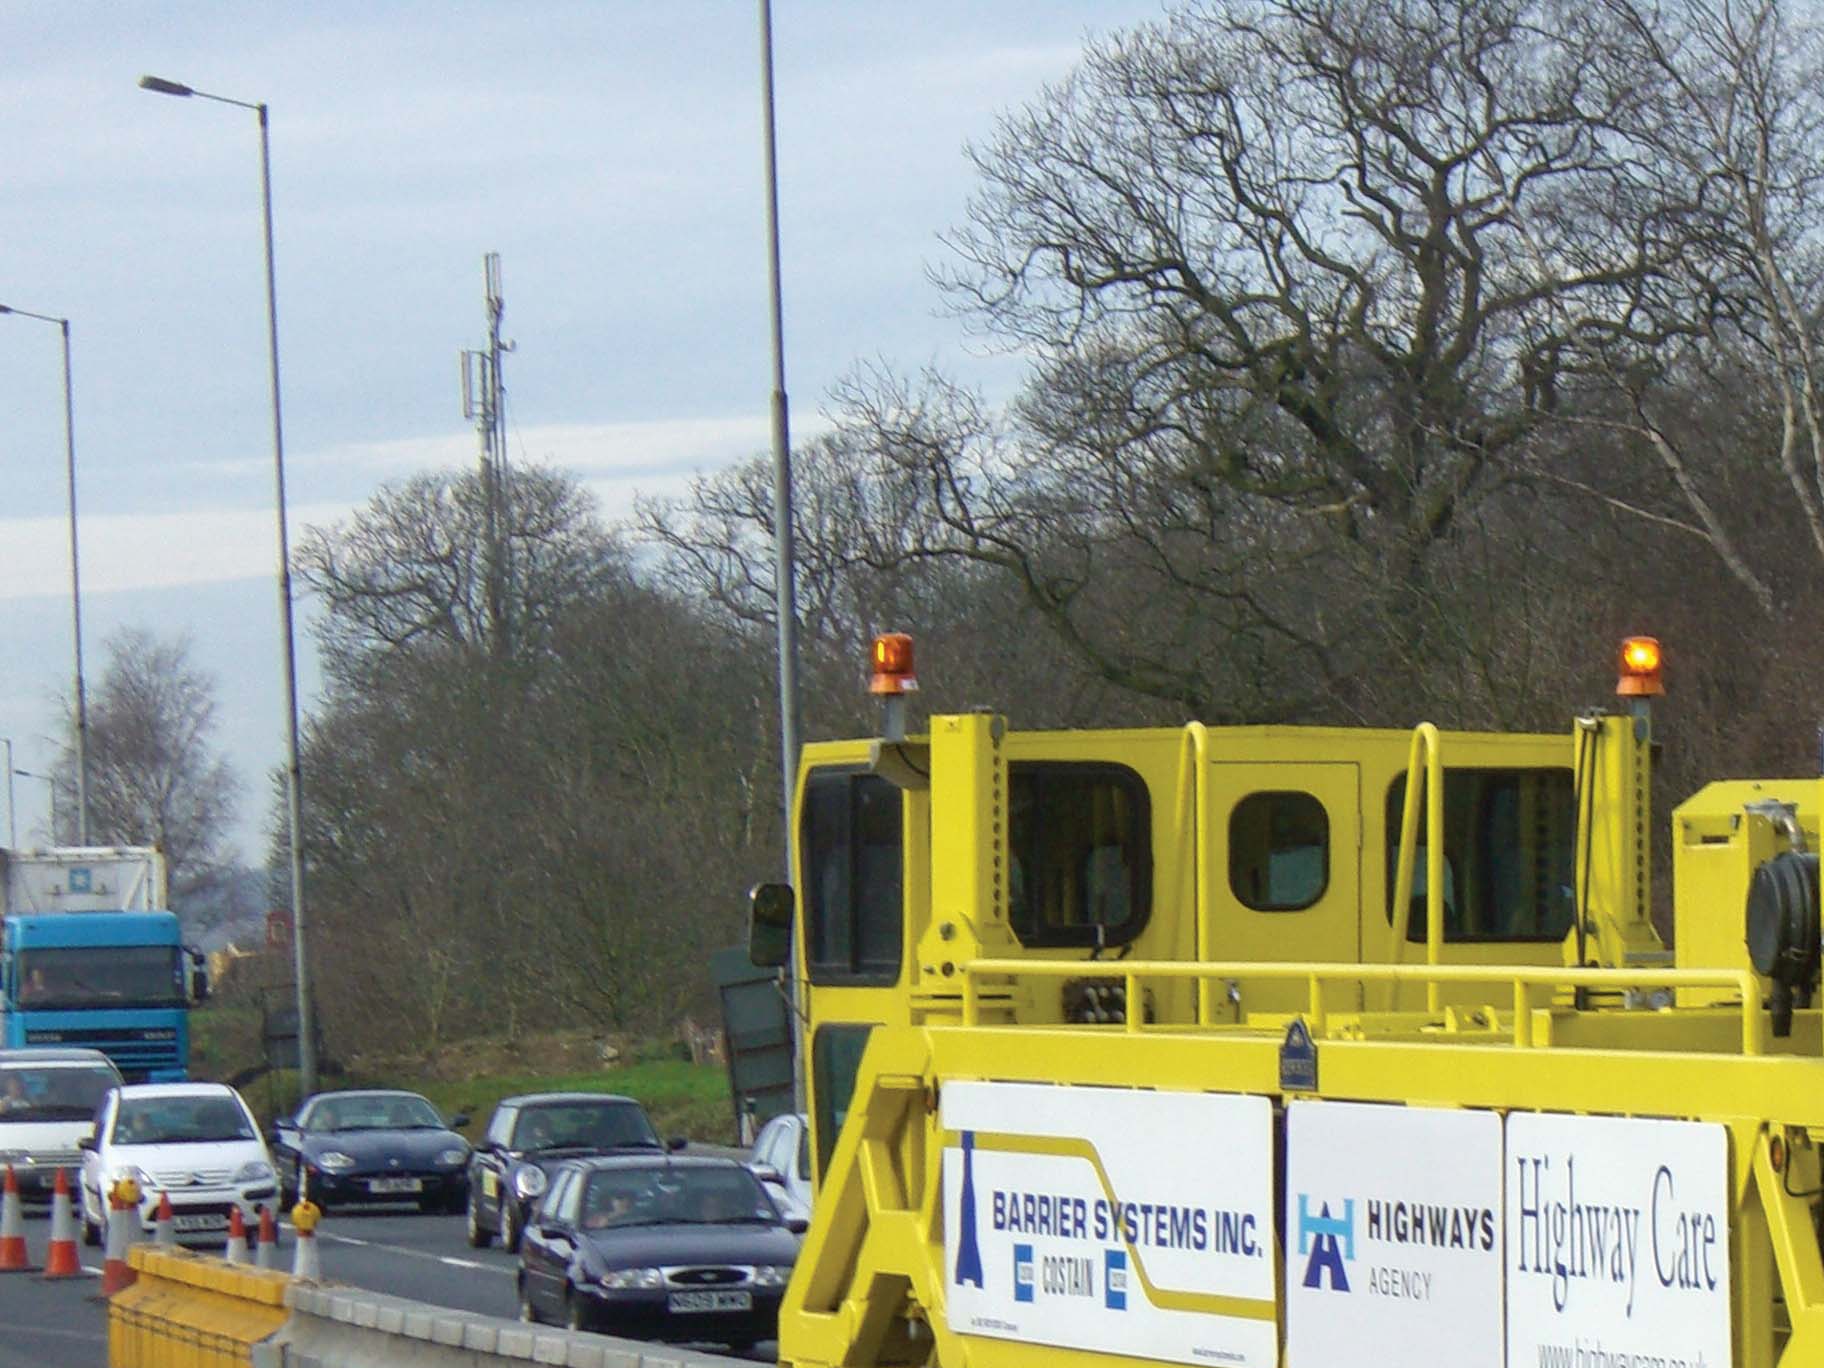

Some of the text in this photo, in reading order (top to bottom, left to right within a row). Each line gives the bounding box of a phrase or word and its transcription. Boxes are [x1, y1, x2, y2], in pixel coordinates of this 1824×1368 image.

[992, 1190, 1264, 1258] BARRIER SYSTEMS INC.
[1367, 1198, 1495, 1252] HIGHWAYS
[1517, 1153, 1718, 1319] Highway Care
[1368, 1266, 1433, 1301] AGENCY
